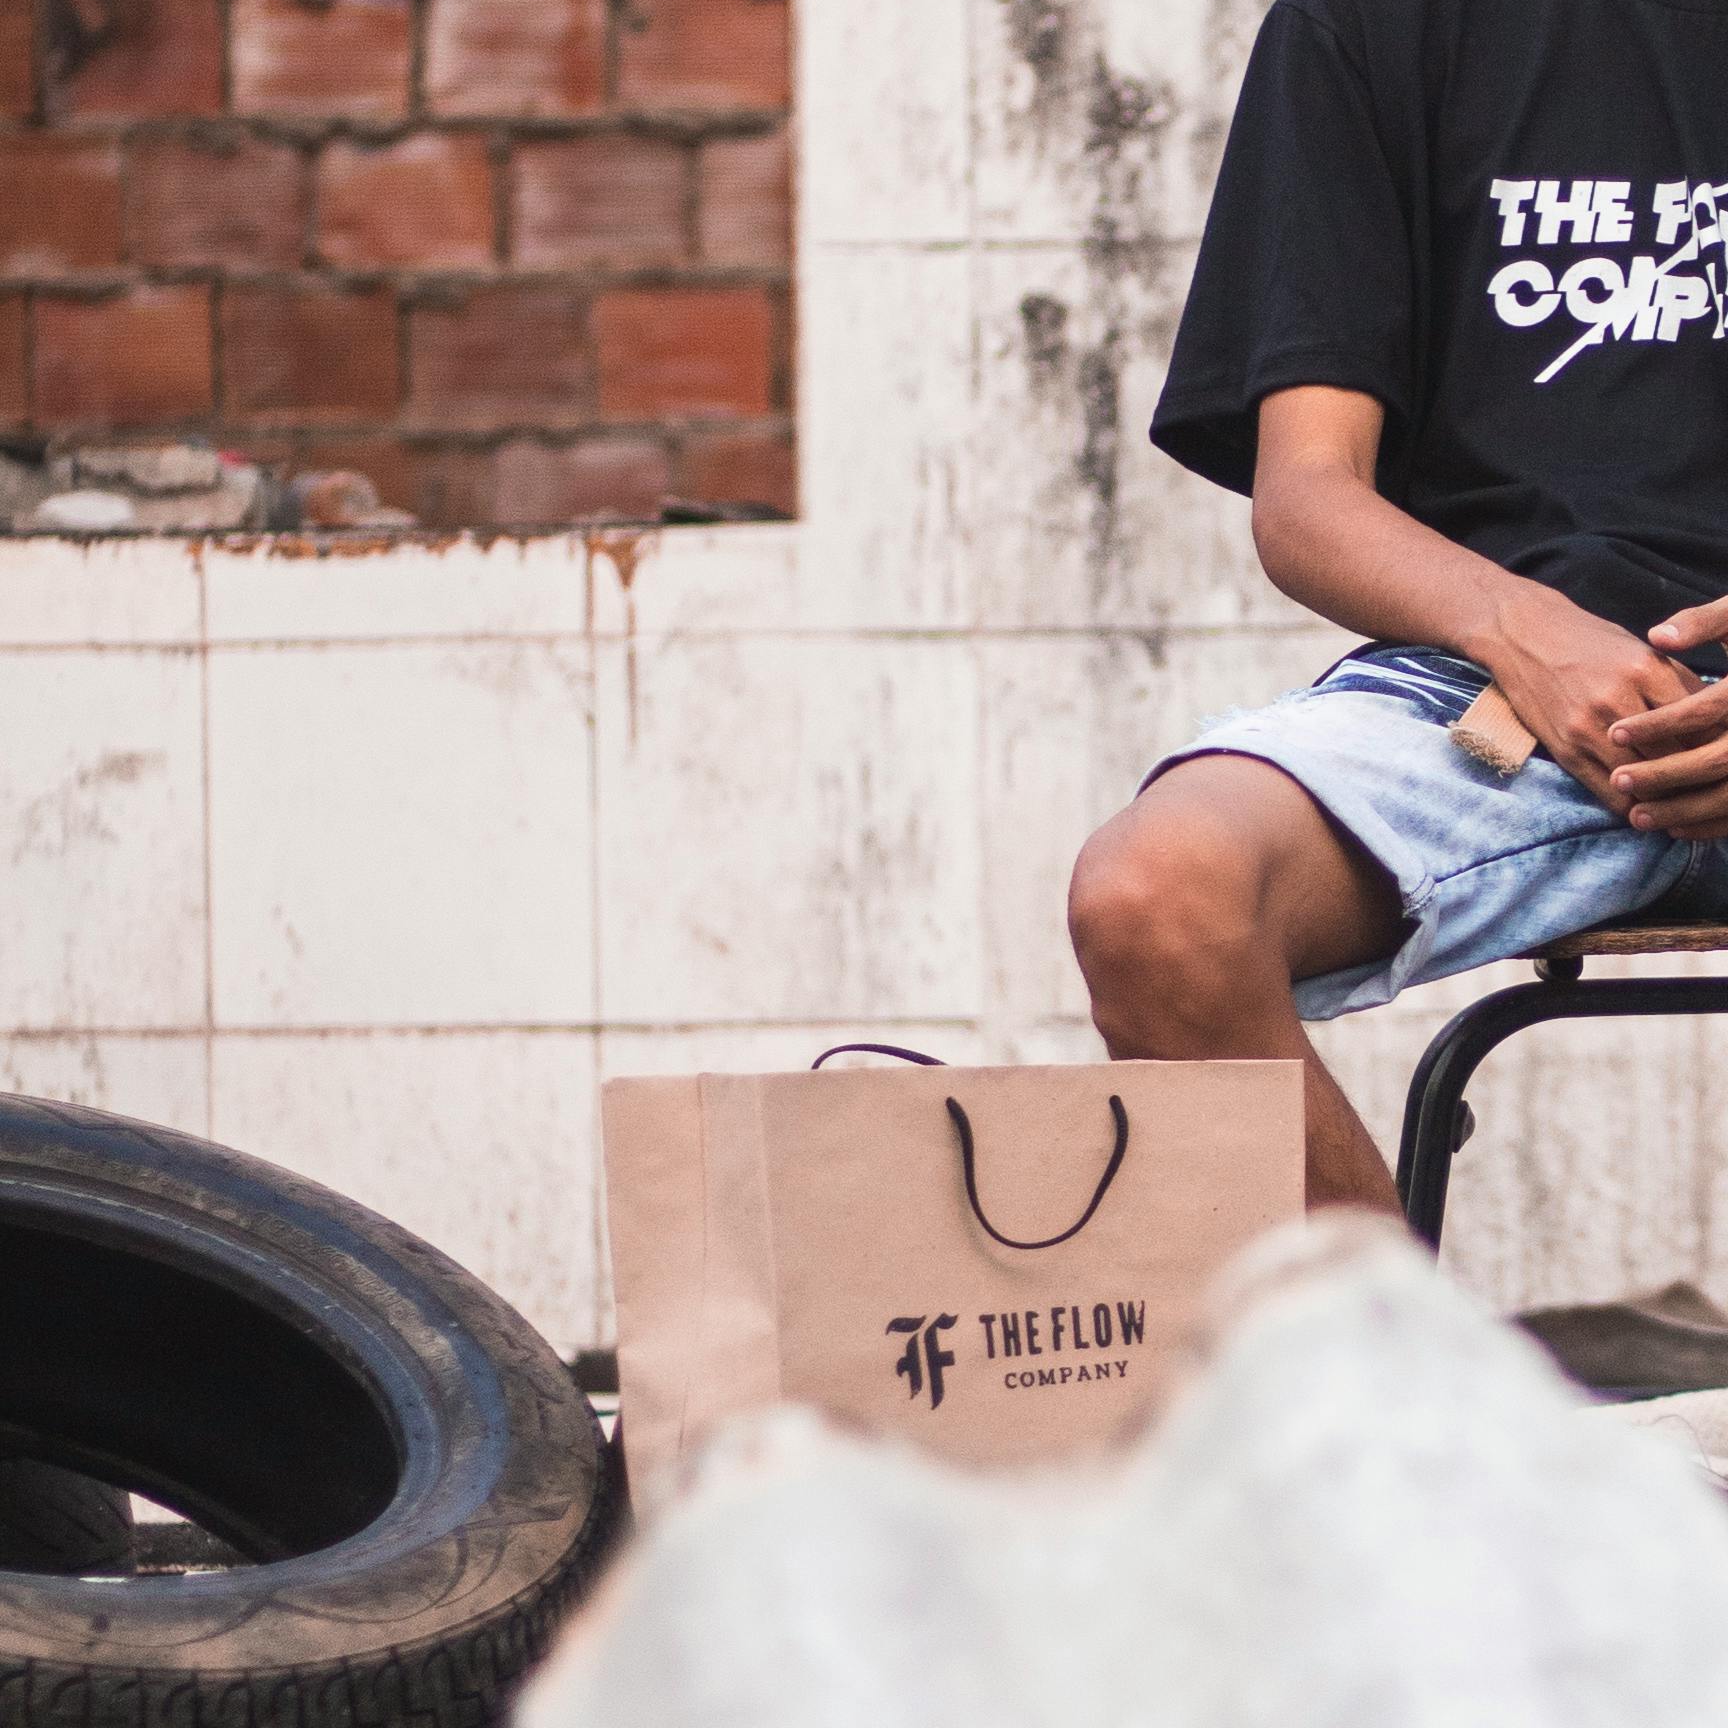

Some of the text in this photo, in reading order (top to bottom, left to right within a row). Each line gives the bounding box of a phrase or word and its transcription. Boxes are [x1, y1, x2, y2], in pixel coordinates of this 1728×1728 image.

[1489, 178, 1635, 247] THE
[978, 1300, 1146, 1359] THE FLOW
[1004, 1360, 1129, 1390] COMPANY
